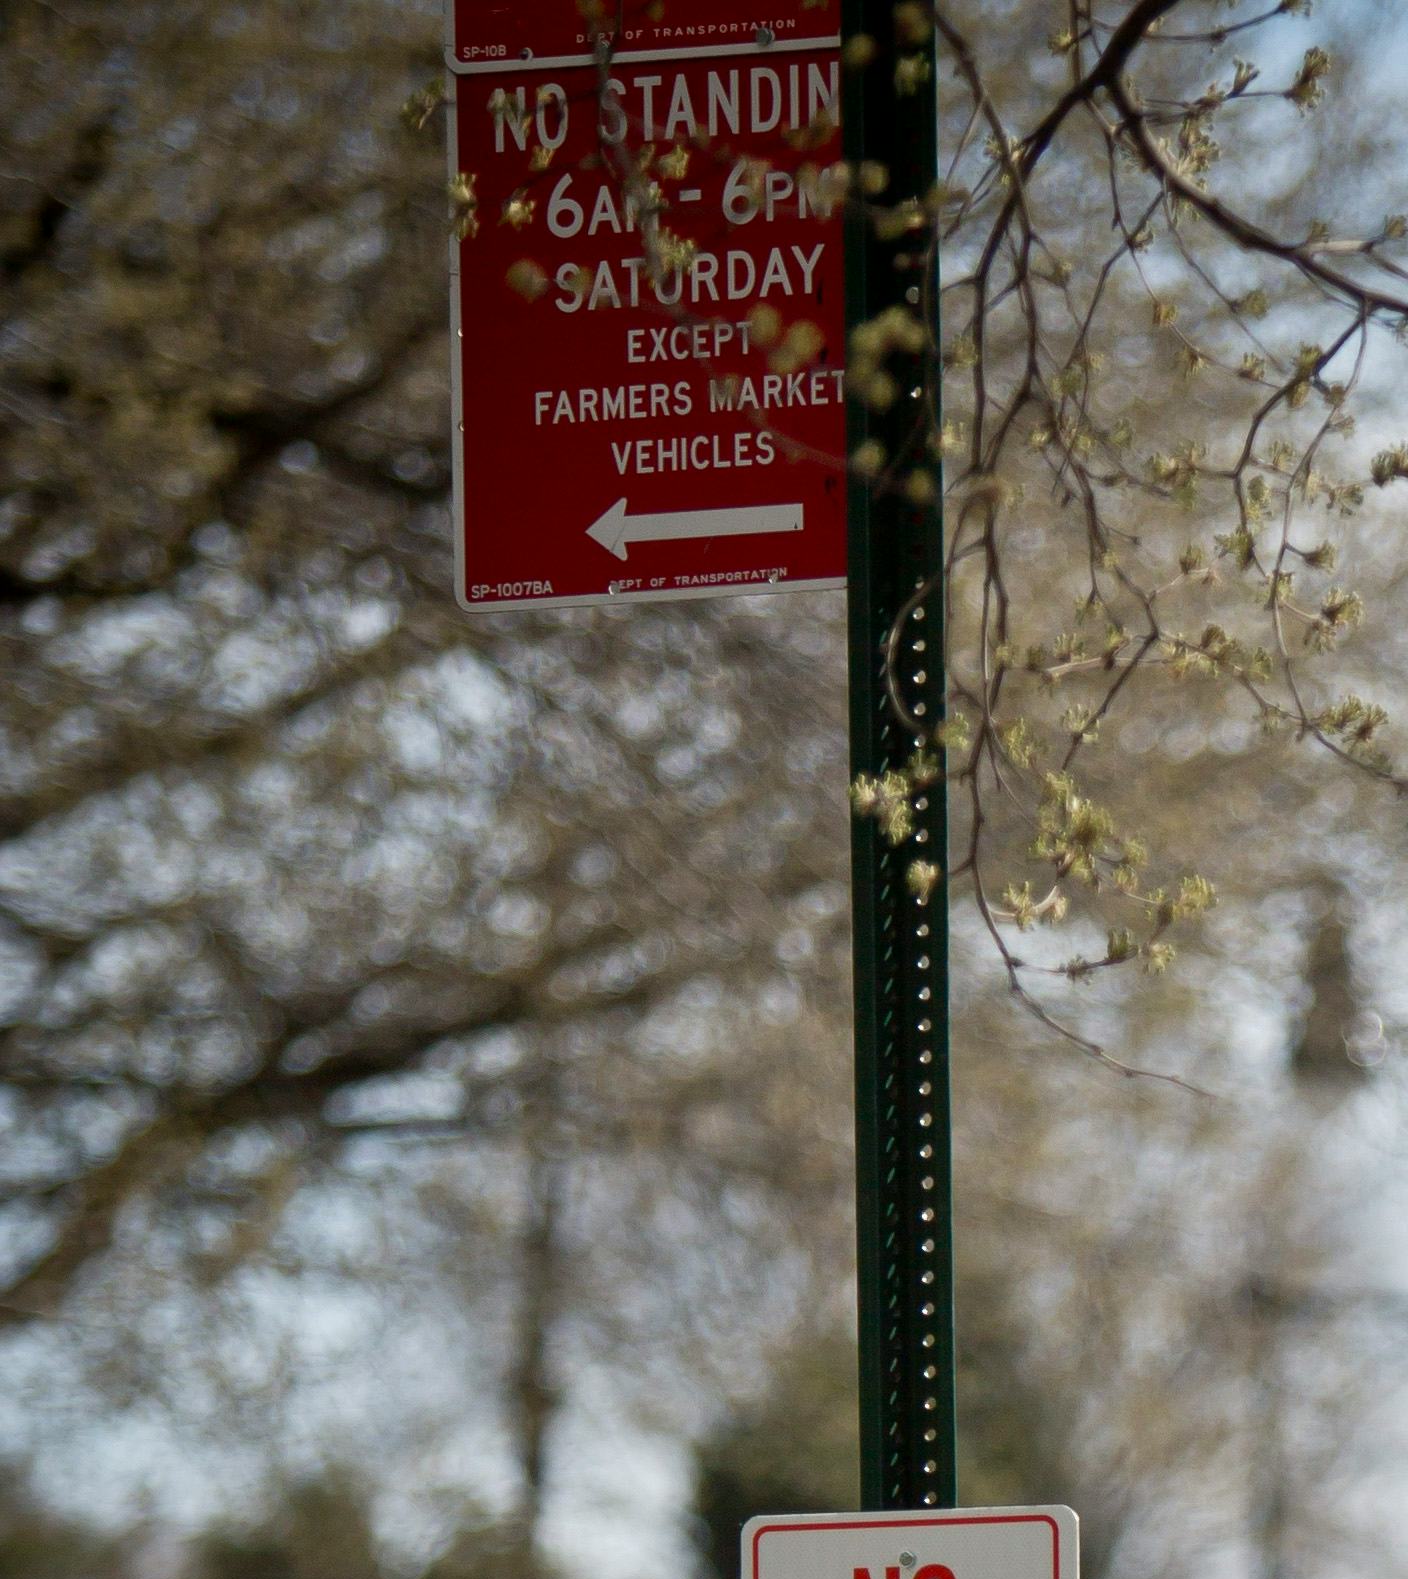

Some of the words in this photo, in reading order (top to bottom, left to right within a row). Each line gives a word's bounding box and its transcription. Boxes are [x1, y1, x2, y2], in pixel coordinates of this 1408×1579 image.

[624, 29, 644, 40] OF
[653, 18, 796, 38] TRANSPORTATION
[463, 44, 507, 59] SP-10B
[491, 83, 569, 153] NO
[599, 62, 840, 143] STANDIN
[546, 172, 660, 239] 6AM
[554, 243, 826, 313] SATURDAY
[627, 322, 753, 363] EXCEPT
[535, 380, 692, 425] FARMERS
[709, 370, 845, 413] MARKET
[612, 432, 775, 475] VEHICLES
[471, 580, 554, 599] SP-1007BA
[650, 577, 667, 587] OF
[674, 567, 788, 585] TRANSPORTATION
